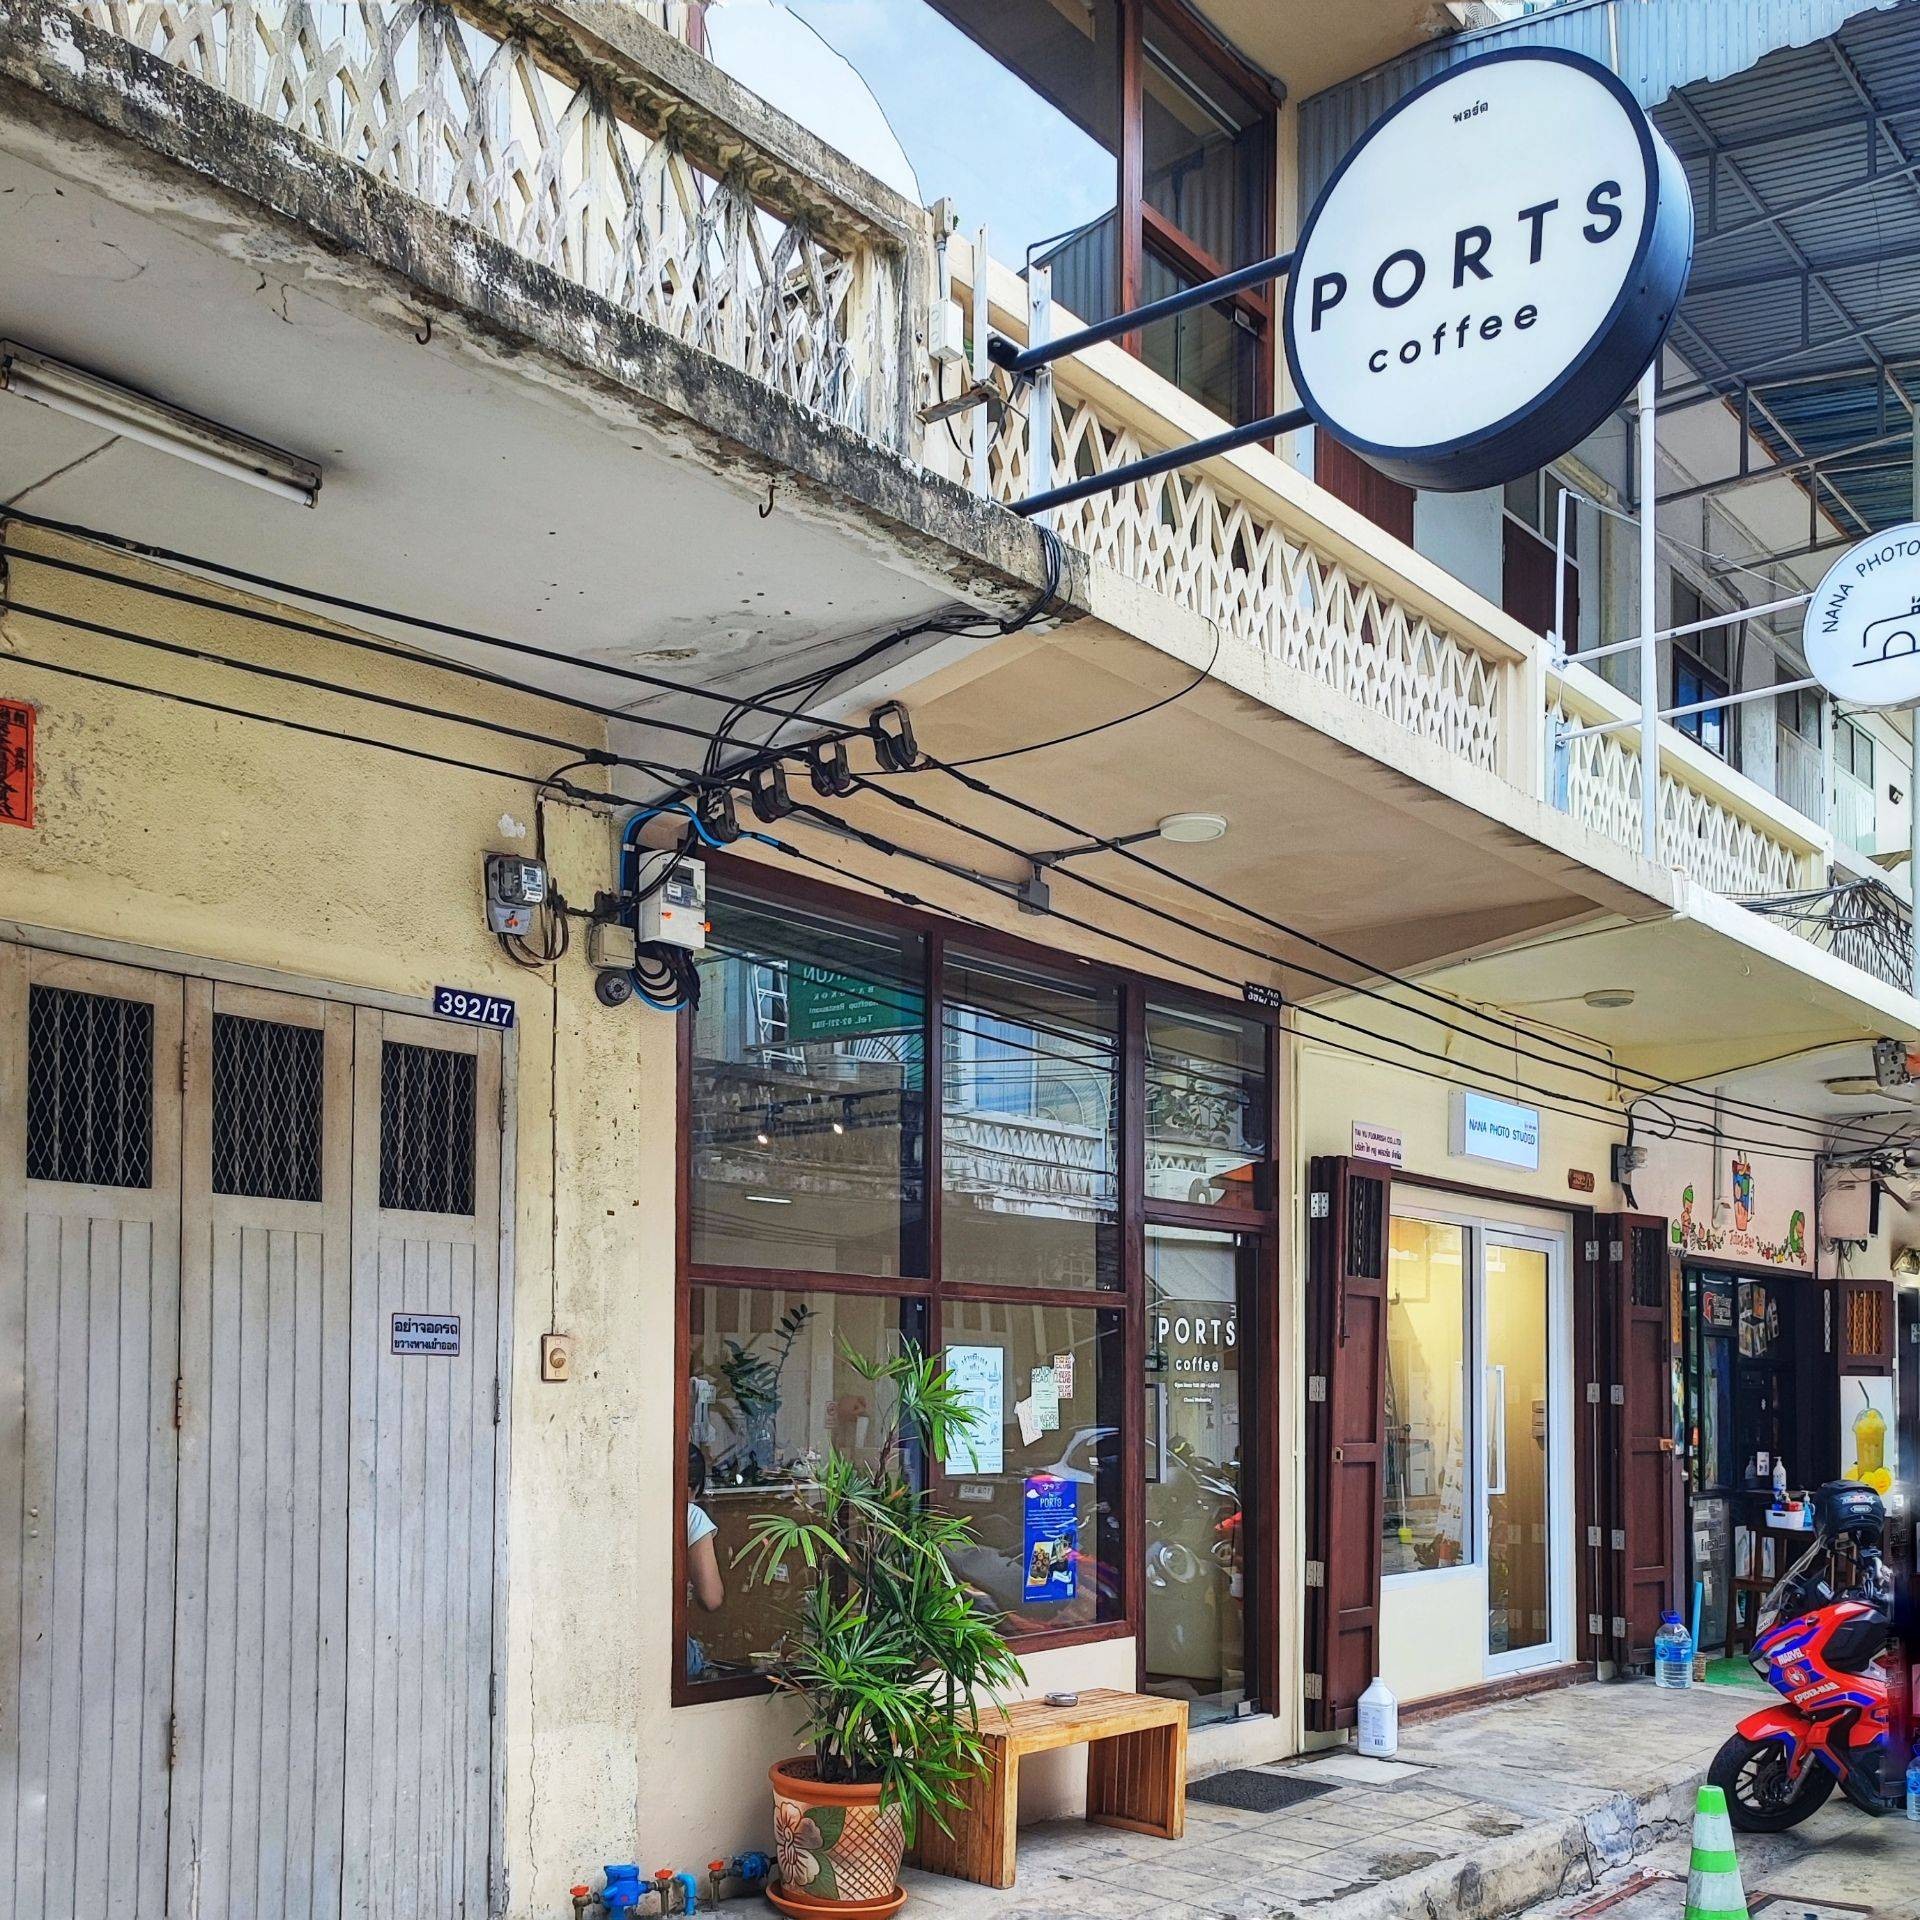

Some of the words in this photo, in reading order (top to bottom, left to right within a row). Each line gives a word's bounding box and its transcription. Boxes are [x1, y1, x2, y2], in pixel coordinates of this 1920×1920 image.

[1311, 180, 1622, 332] PORTS
[1368, 304, 1538, 373] coffee
[1822, 583, 1854, 633] NANA
[1856, 540, 1920, 577] PHOTO
[439, 992, 512, 1025] 392/17
[1469, 1118, 1487, 1133] NANA
[1489, 1124, 1510, 1139] PHOTO
[395, 1318, 458, 1335] อย่าจอดรถ
[1158, 1317, 1236, 1346] PORTS
[394, 1338, 458, 1350] ขวางทางเข้าออก
[1175, 1356, 1219, 1372] coffee
[1040, 1498, 1062, 1508] PORTS
[1776, 1647, 1805, 1665] MARVEL
[1793, 1682, 1840, 1704] SPIDER-MAN
